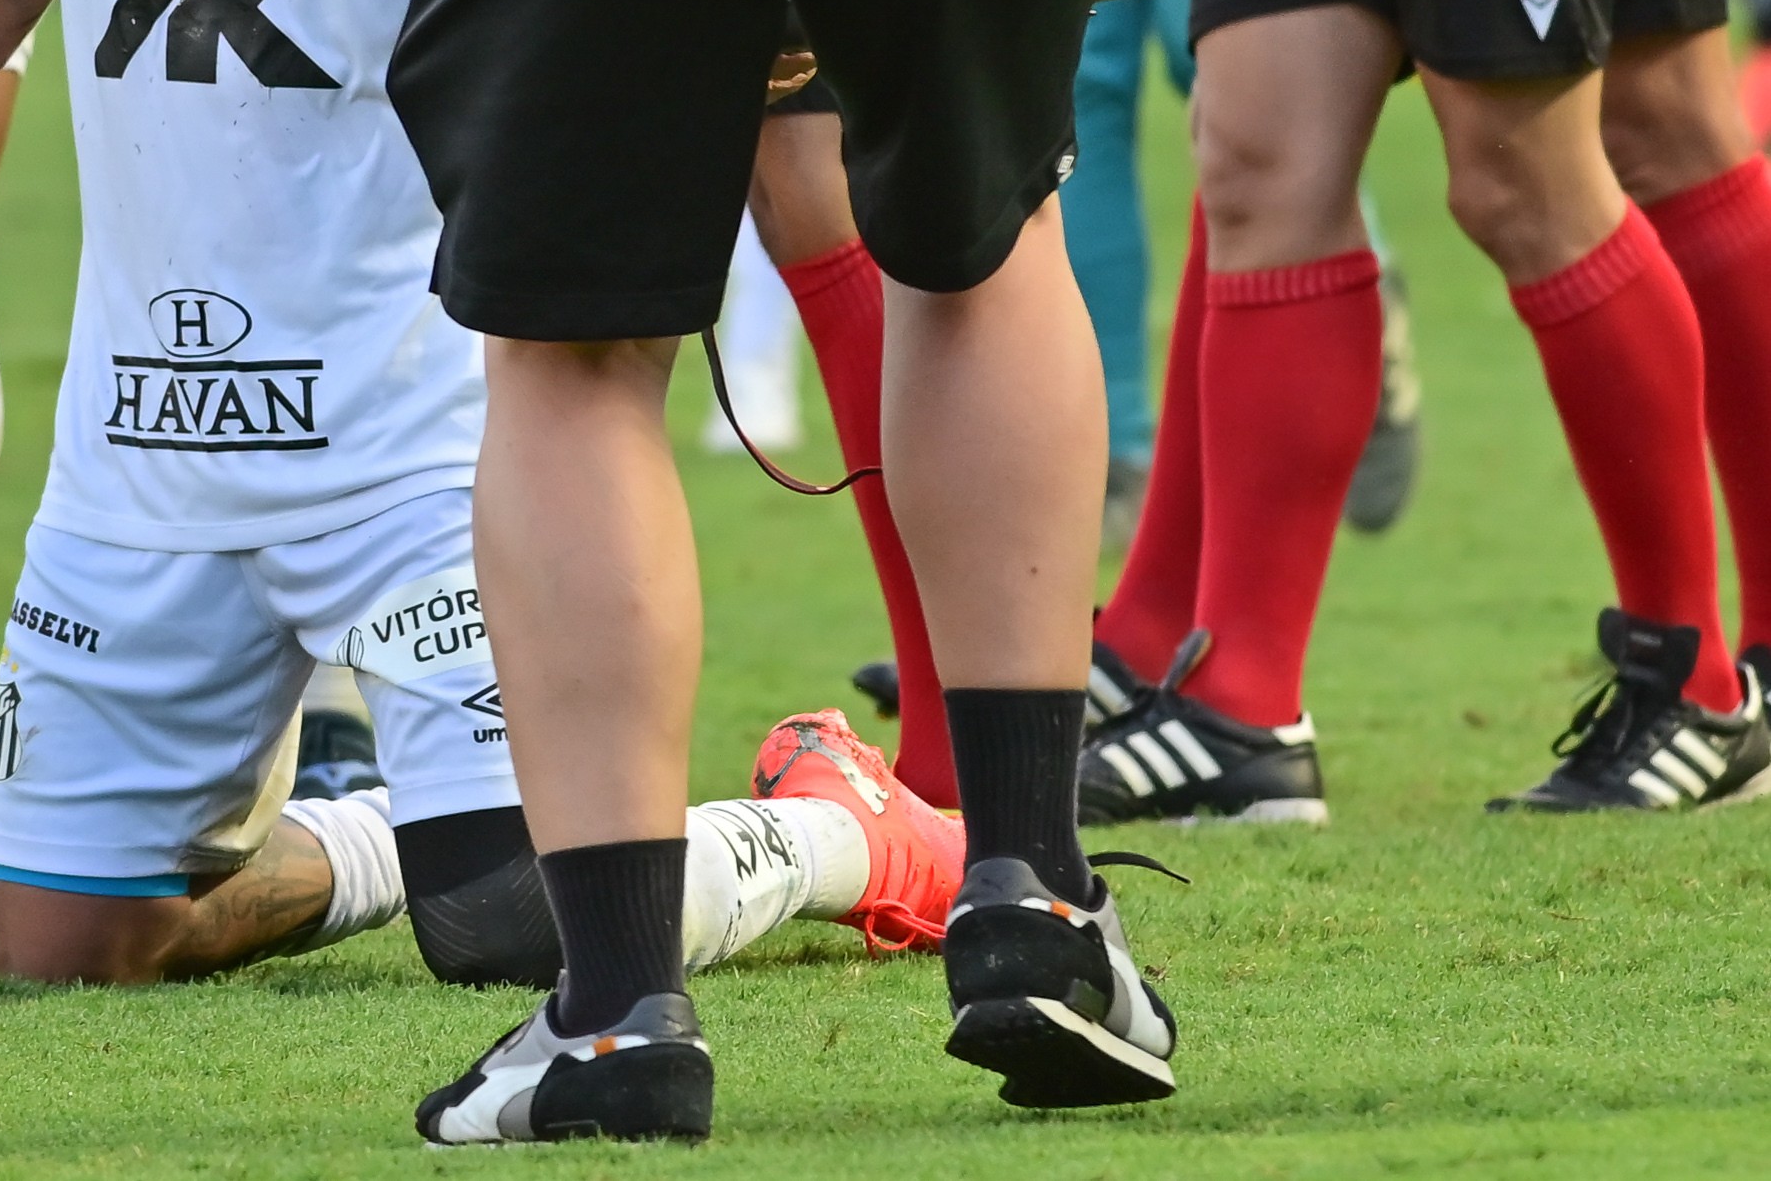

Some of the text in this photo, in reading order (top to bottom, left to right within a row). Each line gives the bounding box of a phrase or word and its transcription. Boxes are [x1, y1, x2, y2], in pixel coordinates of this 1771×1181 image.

[171, 299, 215, 348] H
[103, 371, 320, 436] HAVAN
[413, 622, 487, 663] CUP
